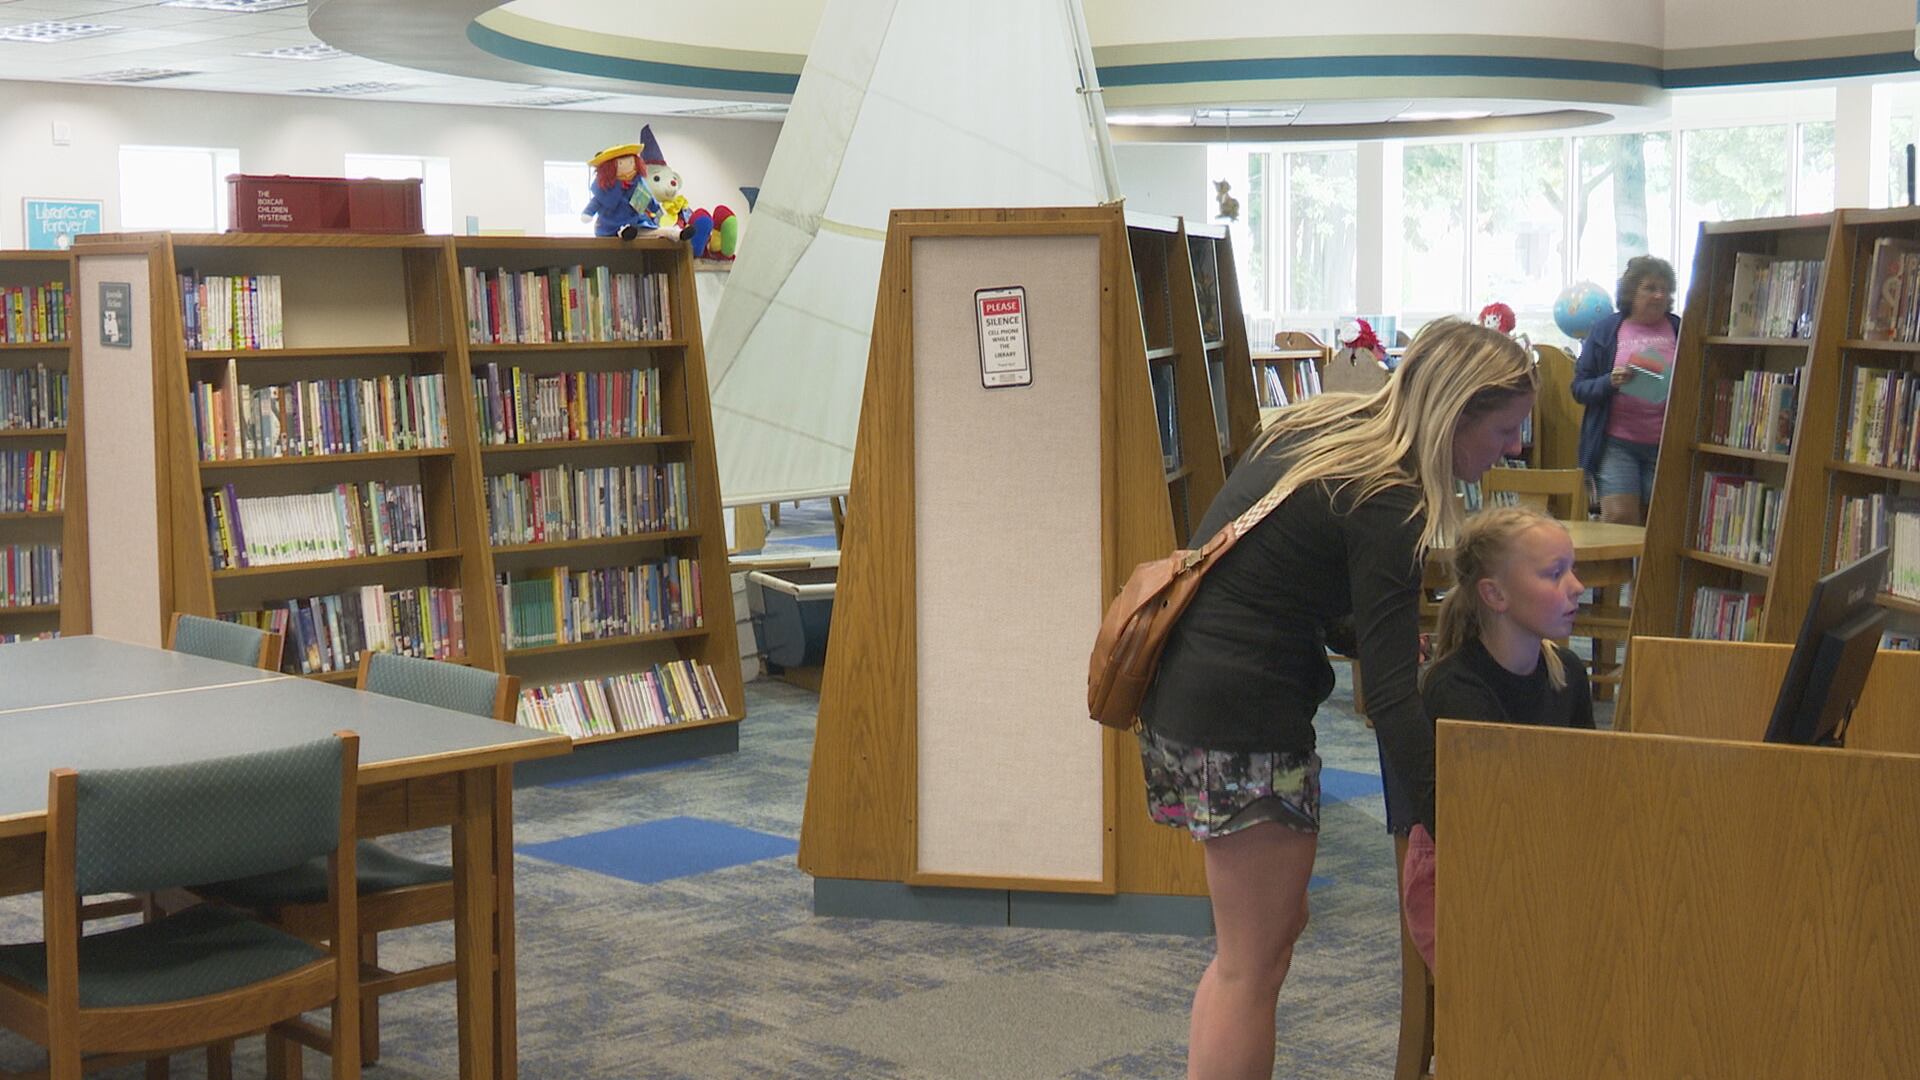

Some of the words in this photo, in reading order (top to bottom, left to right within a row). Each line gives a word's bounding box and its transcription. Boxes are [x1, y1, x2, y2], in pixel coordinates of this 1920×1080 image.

[257, 214, 293, 222] MYSTERIES
[986, 302, 1017, 312] PLEASE
[986, 316, 1020, 327] SILENCE
